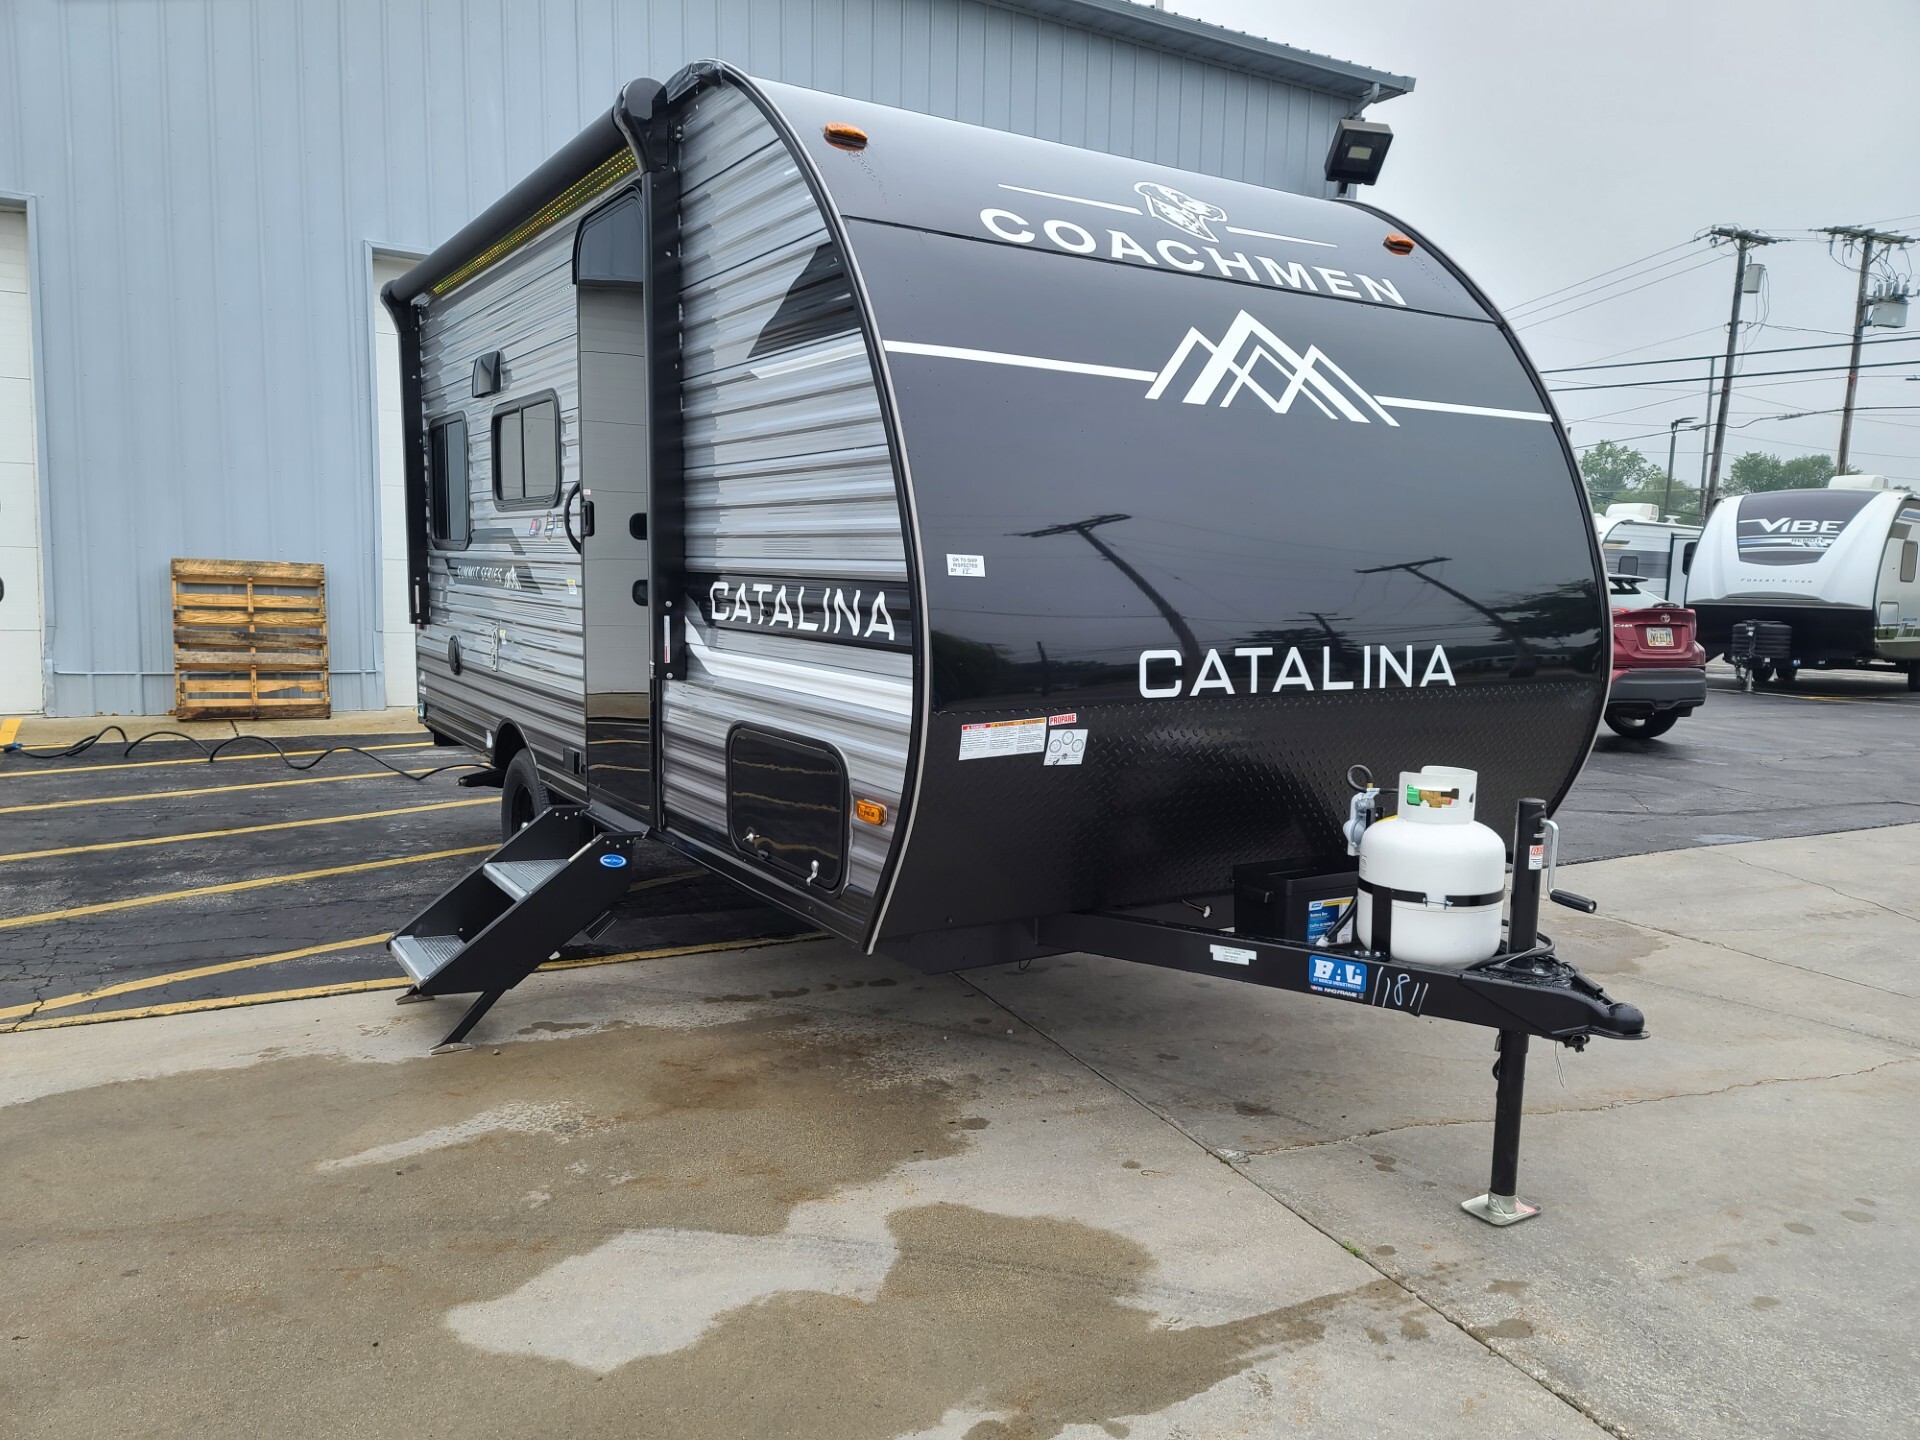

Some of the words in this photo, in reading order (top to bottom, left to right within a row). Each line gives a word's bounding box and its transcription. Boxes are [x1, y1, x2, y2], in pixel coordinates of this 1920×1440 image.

[980, 207, 1408, 306] COACHMEN
[1756, 517, 1845, 534] VIBE
[457, 565, 480, 580] SUMMIT
[481, 566, 503, 582] SERIES
[709, 581, 895, 641] CATALINA
[1138, 644, 1457, 699] CATALINA
[1050, 714, 1076, 725] PROPANE
[1313, 959, 1363, 985] BAL
